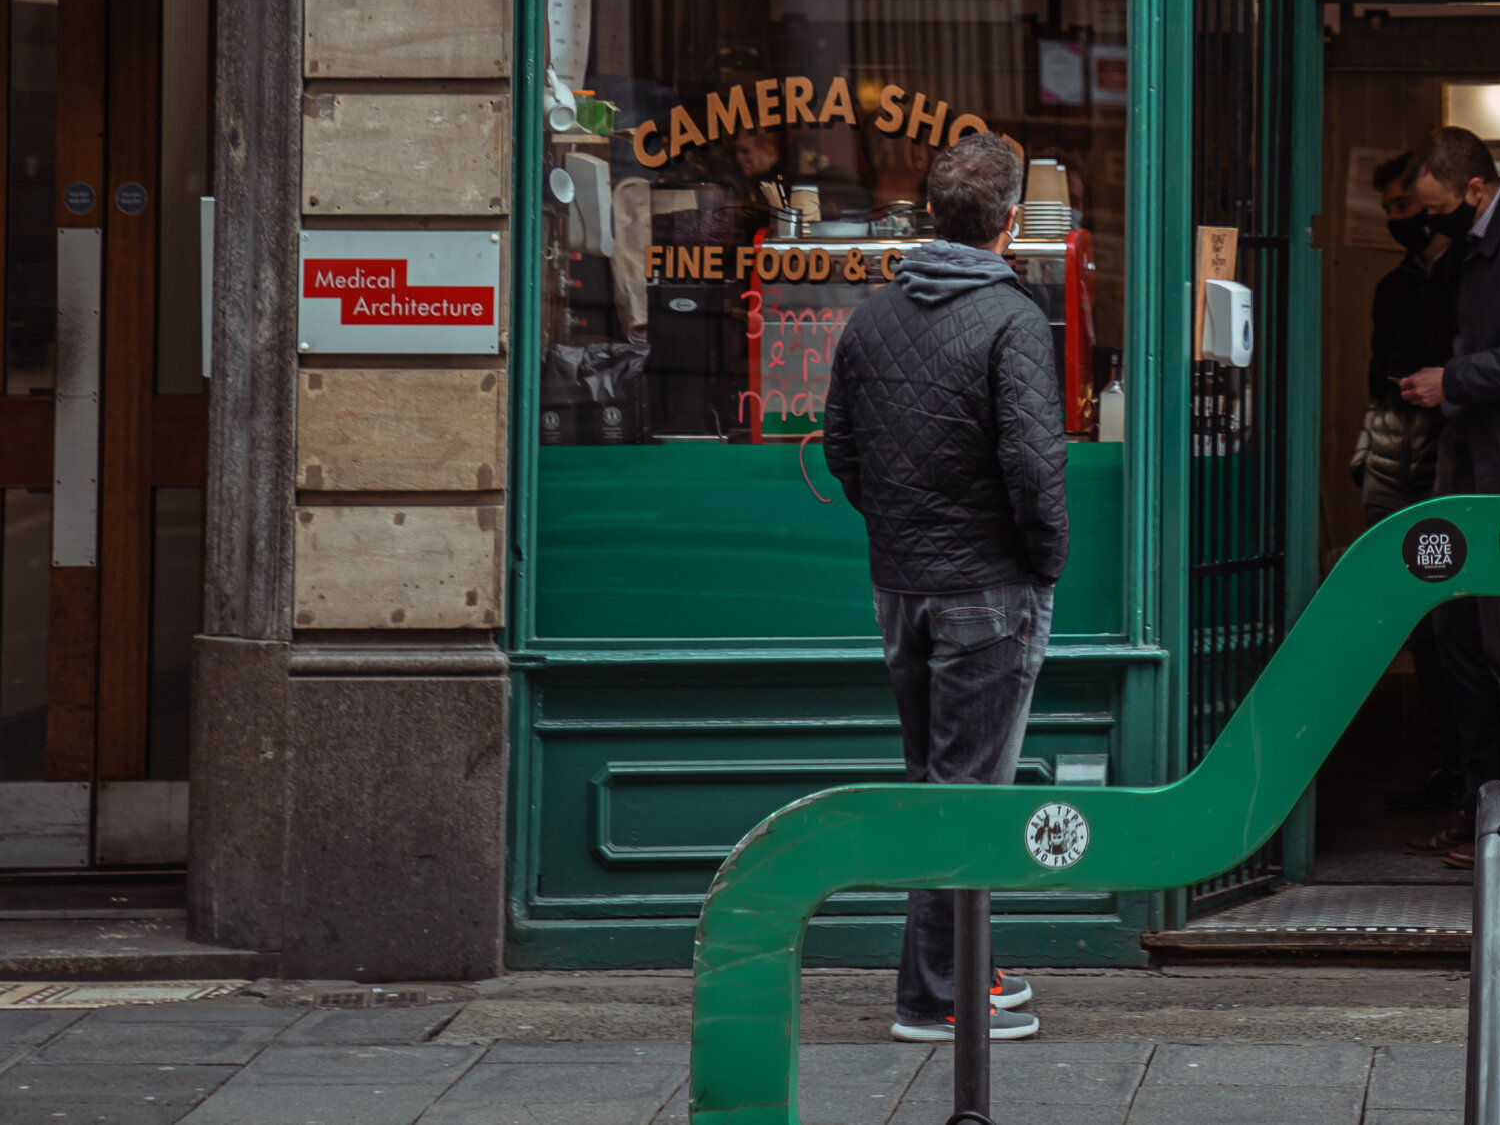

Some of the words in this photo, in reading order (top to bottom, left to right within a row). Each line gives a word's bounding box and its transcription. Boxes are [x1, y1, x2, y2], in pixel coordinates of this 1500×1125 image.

[633, 75, 859, 170] CAMERA
[645, 245, 724, 281] FINE
[736, 246, 831, 283] FOOD
[843, 247, 868, 282] &
[315, 267, 396, 290] Medical
[352, 293, 484, 317] Architecture
[1418, 544, 1452, 555] SAVE
[1419, 534, 1450, 545] GOD
[1417, 554, 1453, 565] IBIZA
[1031, 809, 1049, 829] ALL
[1056, 806, 1084, 828] TYPE
[1033, 847, 1048, 862] NO
[1054, 847, 1081, 866] FACE
